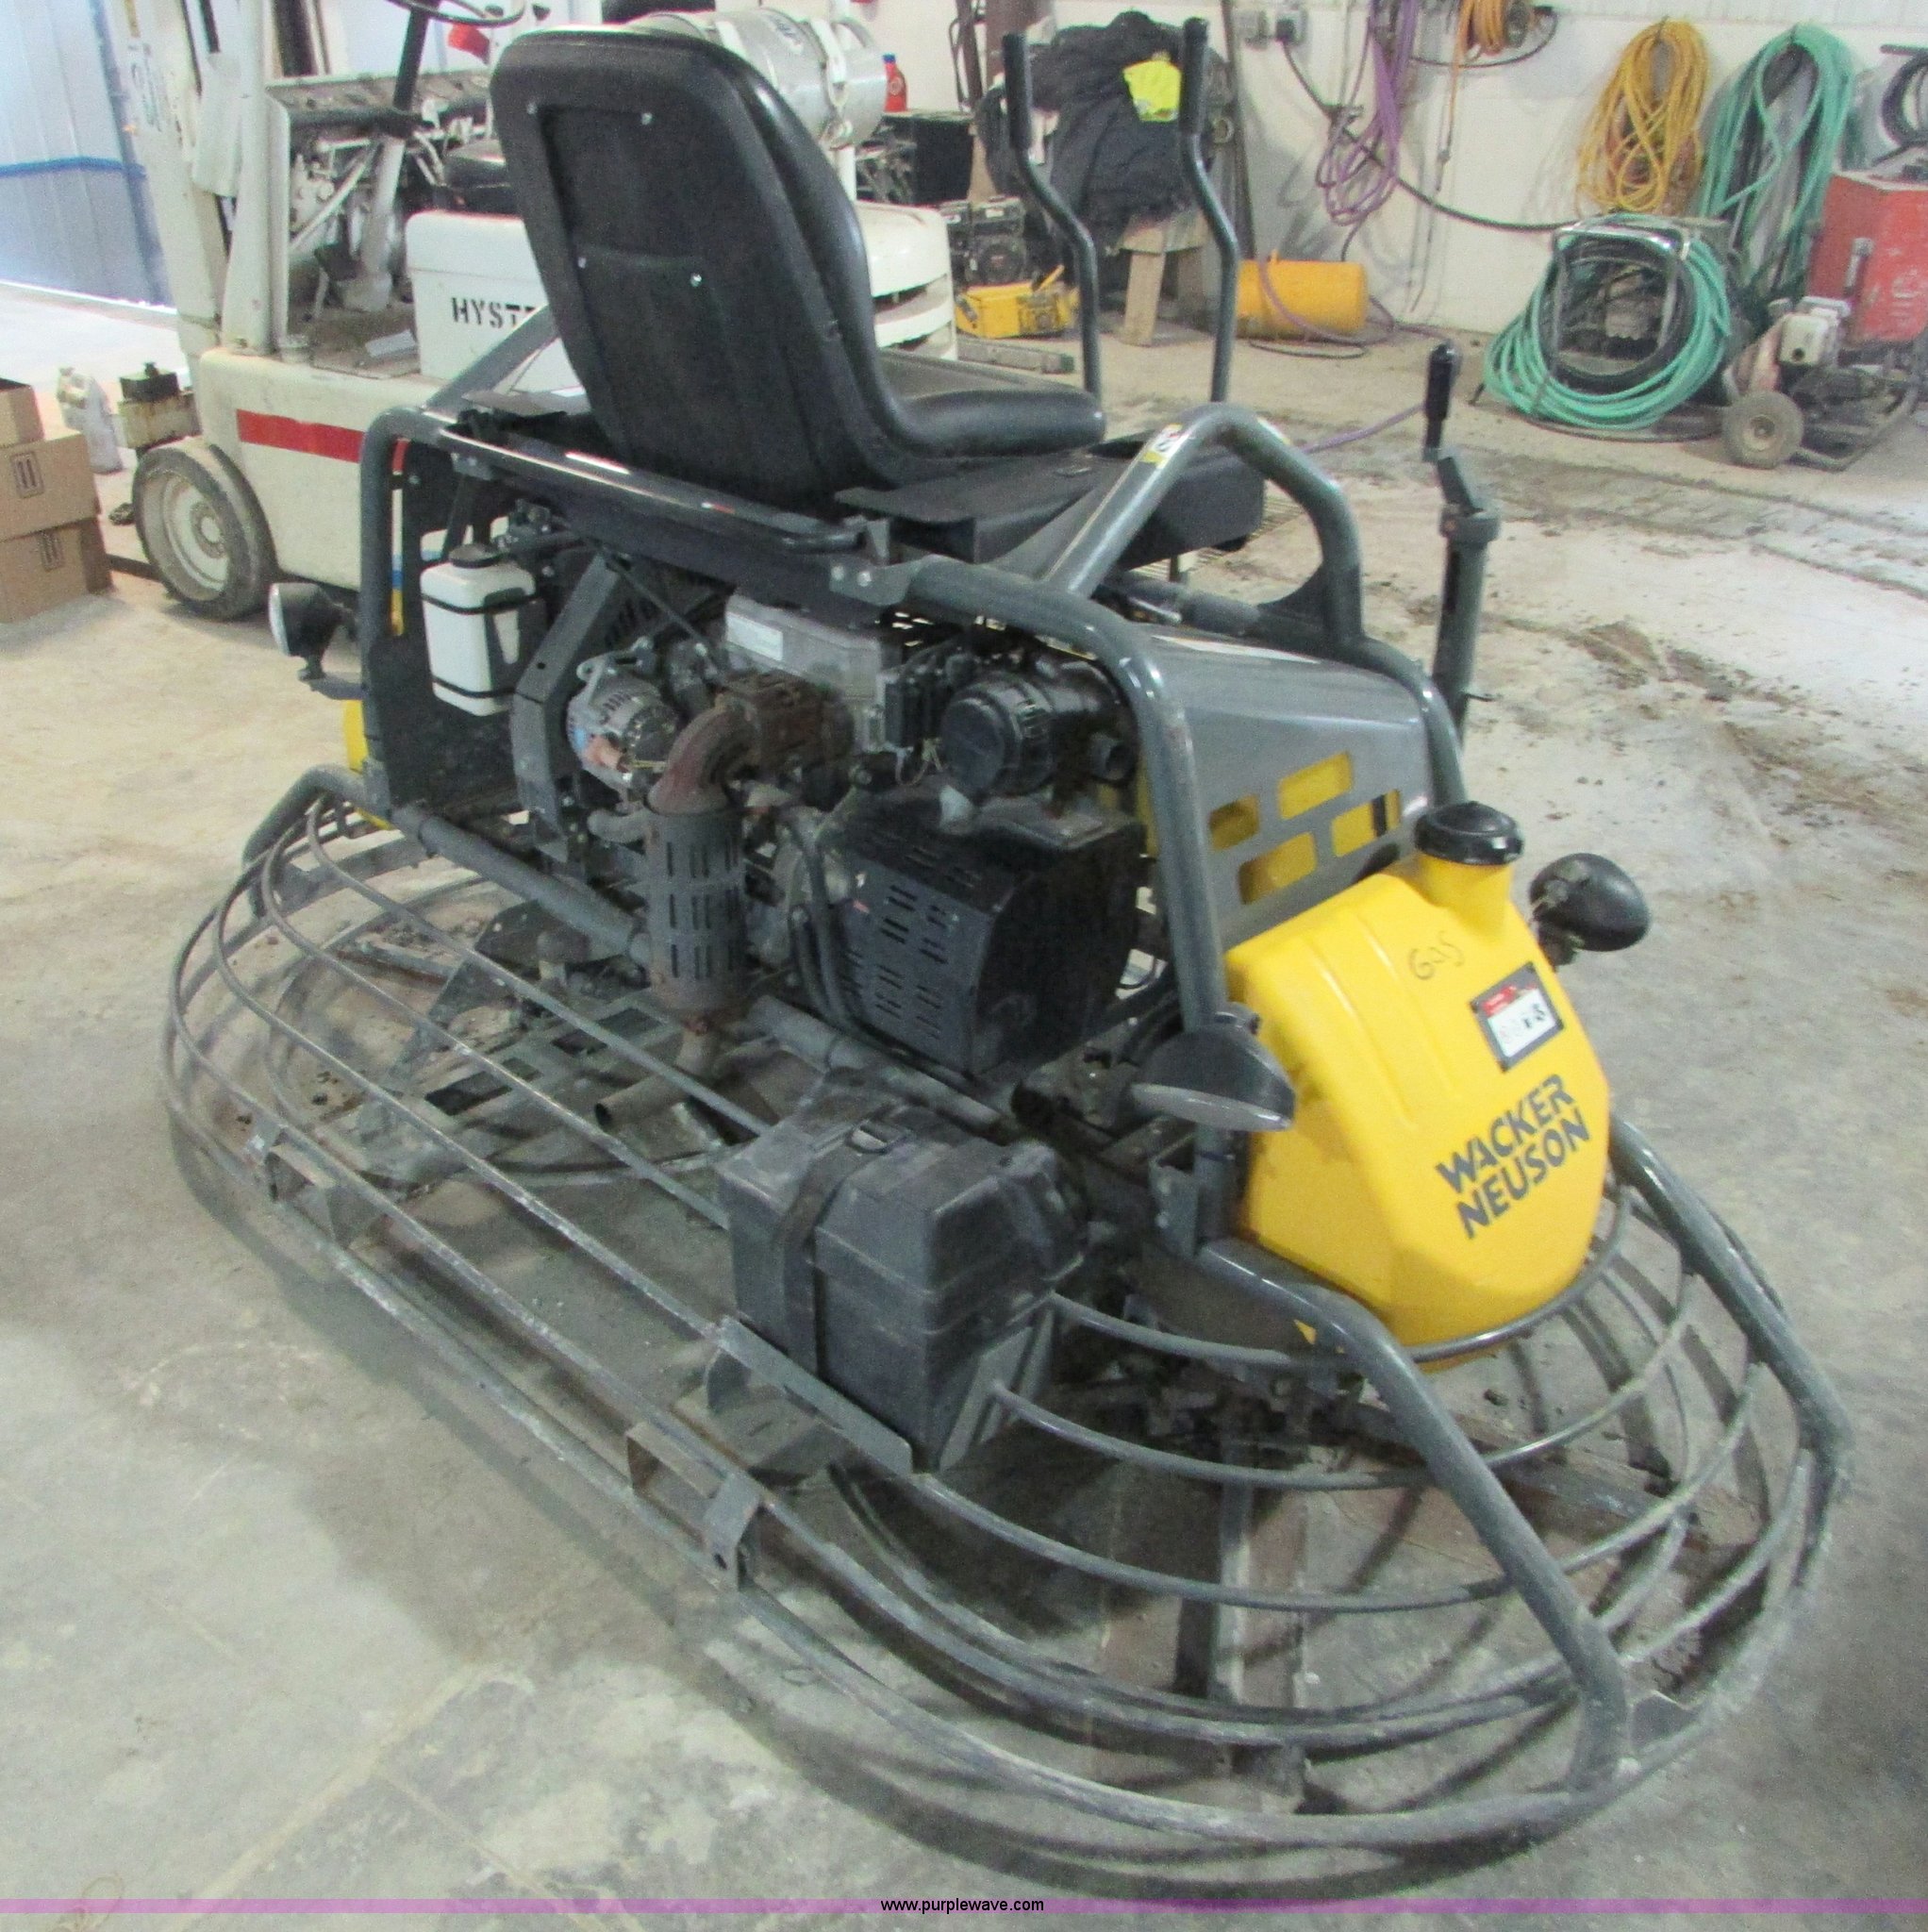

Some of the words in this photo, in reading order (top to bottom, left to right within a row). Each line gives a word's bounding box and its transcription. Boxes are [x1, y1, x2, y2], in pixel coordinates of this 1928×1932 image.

[451, 296, 536, 328] HYST
[1435, 1074, 1575, 1195] WACKER
[1456, 1107, 1591, 1241] NEUSON
